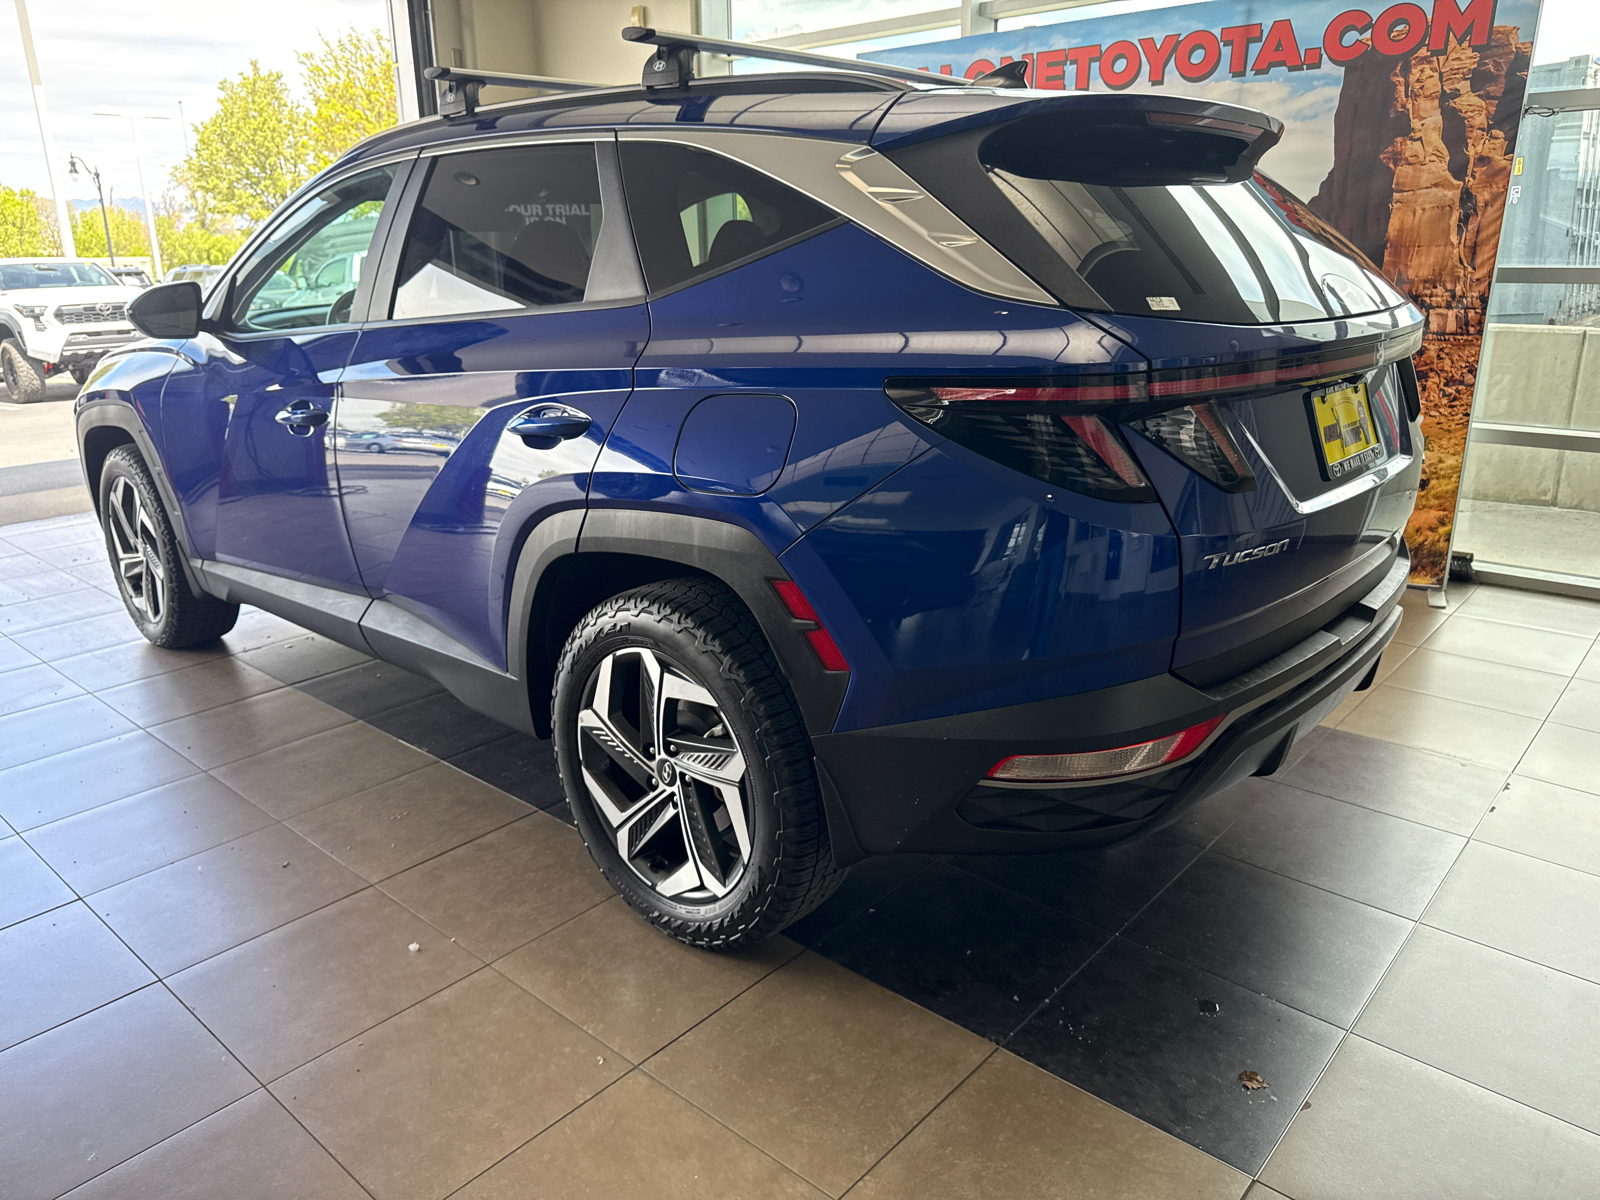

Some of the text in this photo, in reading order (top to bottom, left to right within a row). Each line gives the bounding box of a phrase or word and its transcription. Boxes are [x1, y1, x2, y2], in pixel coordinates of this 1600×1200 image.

[917, 0, 1495, 91] NETOYOTA.COM
[504, 203, 590, 216] OUR TRIAL
